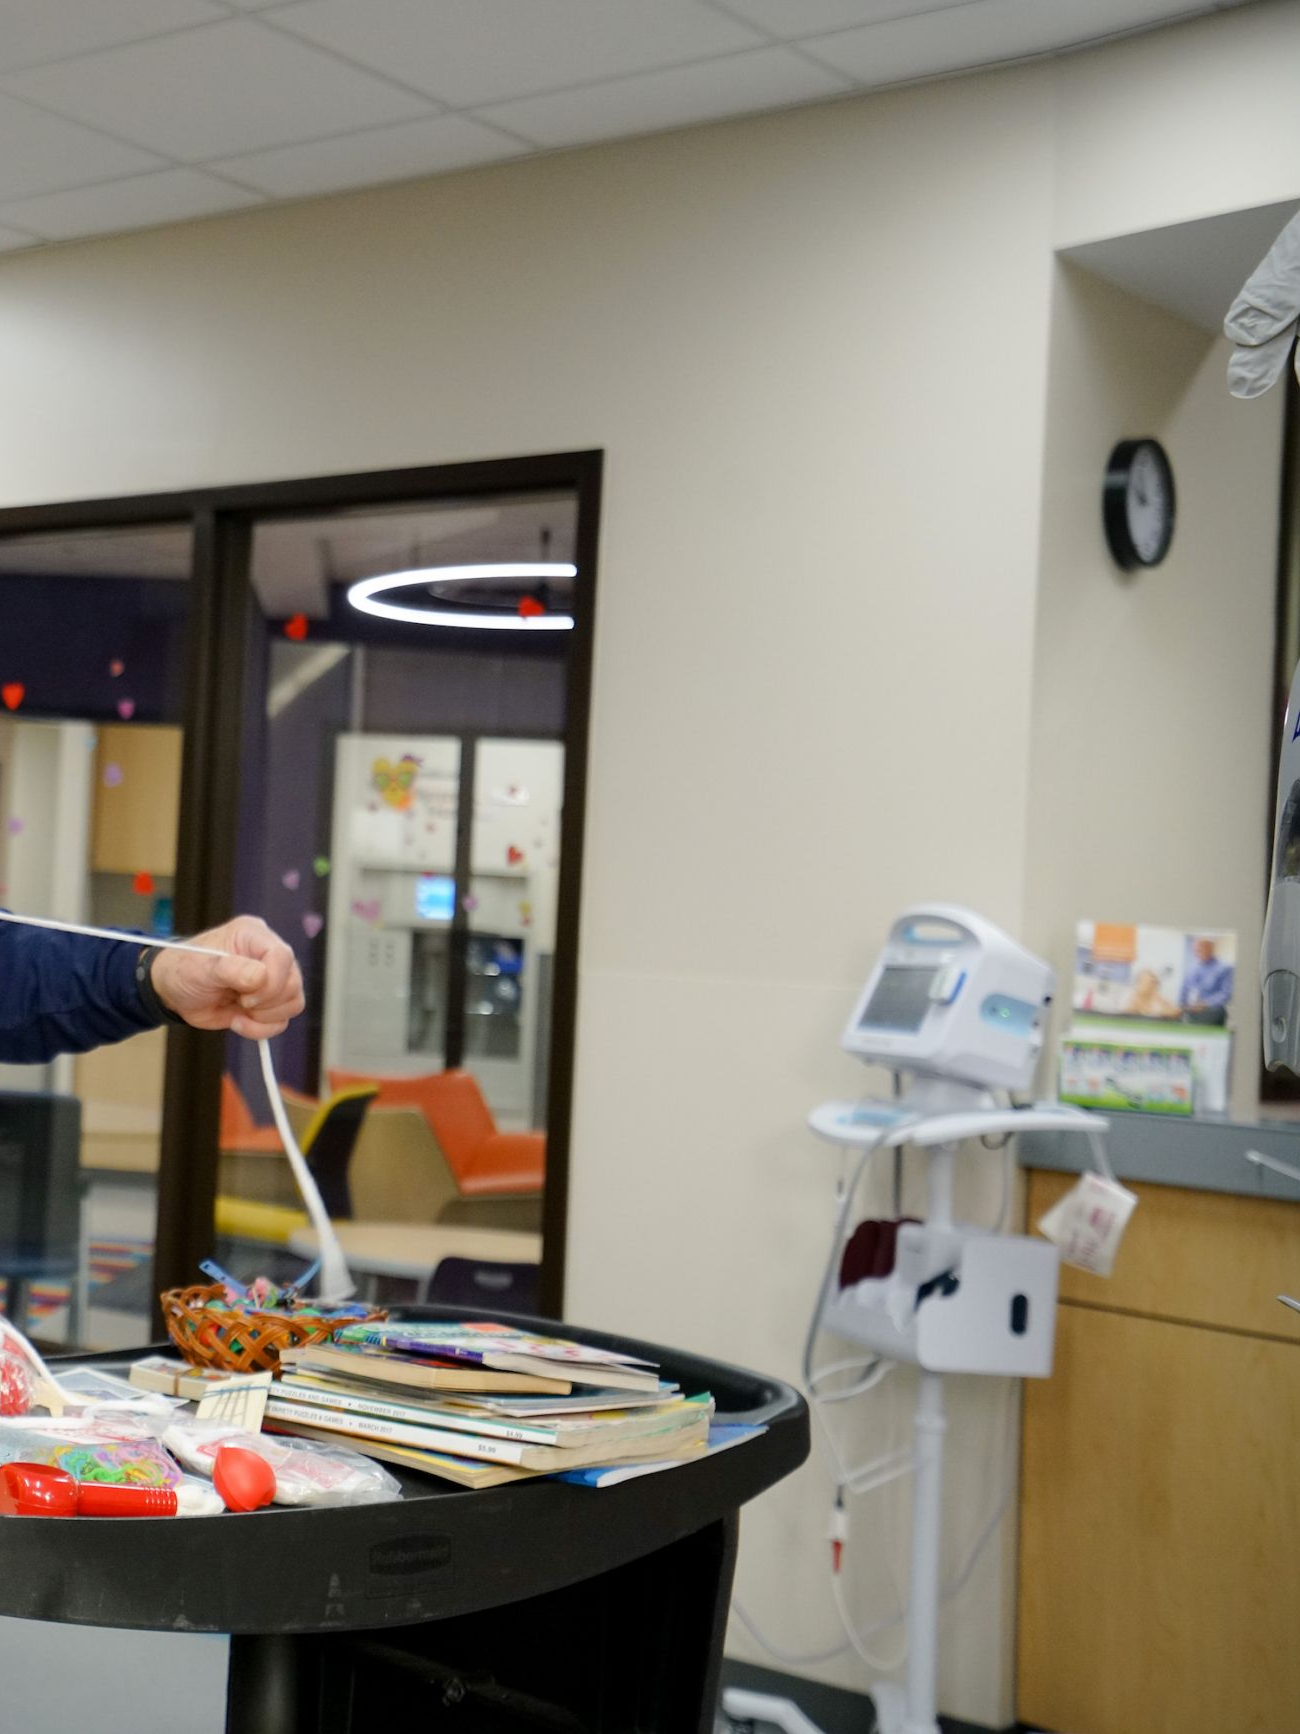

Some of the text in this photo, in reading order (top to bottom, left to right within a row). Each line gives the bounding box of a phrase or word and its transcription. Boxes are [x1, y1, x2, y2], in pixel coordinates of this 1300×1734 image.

[281, 1389, 306, 1400] PUZZLES
[308, 1393, 320, 1402] AND
[321, 1396, 343, 1406] GAMES
[358, 1403, 392, 1416] NOVEMBER
[392, 1409, 407, 1418] 2017
[293, 1409, 318, 1420] PUZZLES
[324, 1415, 344, 1425] GAMES
[358, 1422, 380, 1432] MARCH
[380, 1425, 393, 1434] 2017
[506, 1430, 522, 1439] $4.99
[478, 1445, 496, 1453] $5.99
